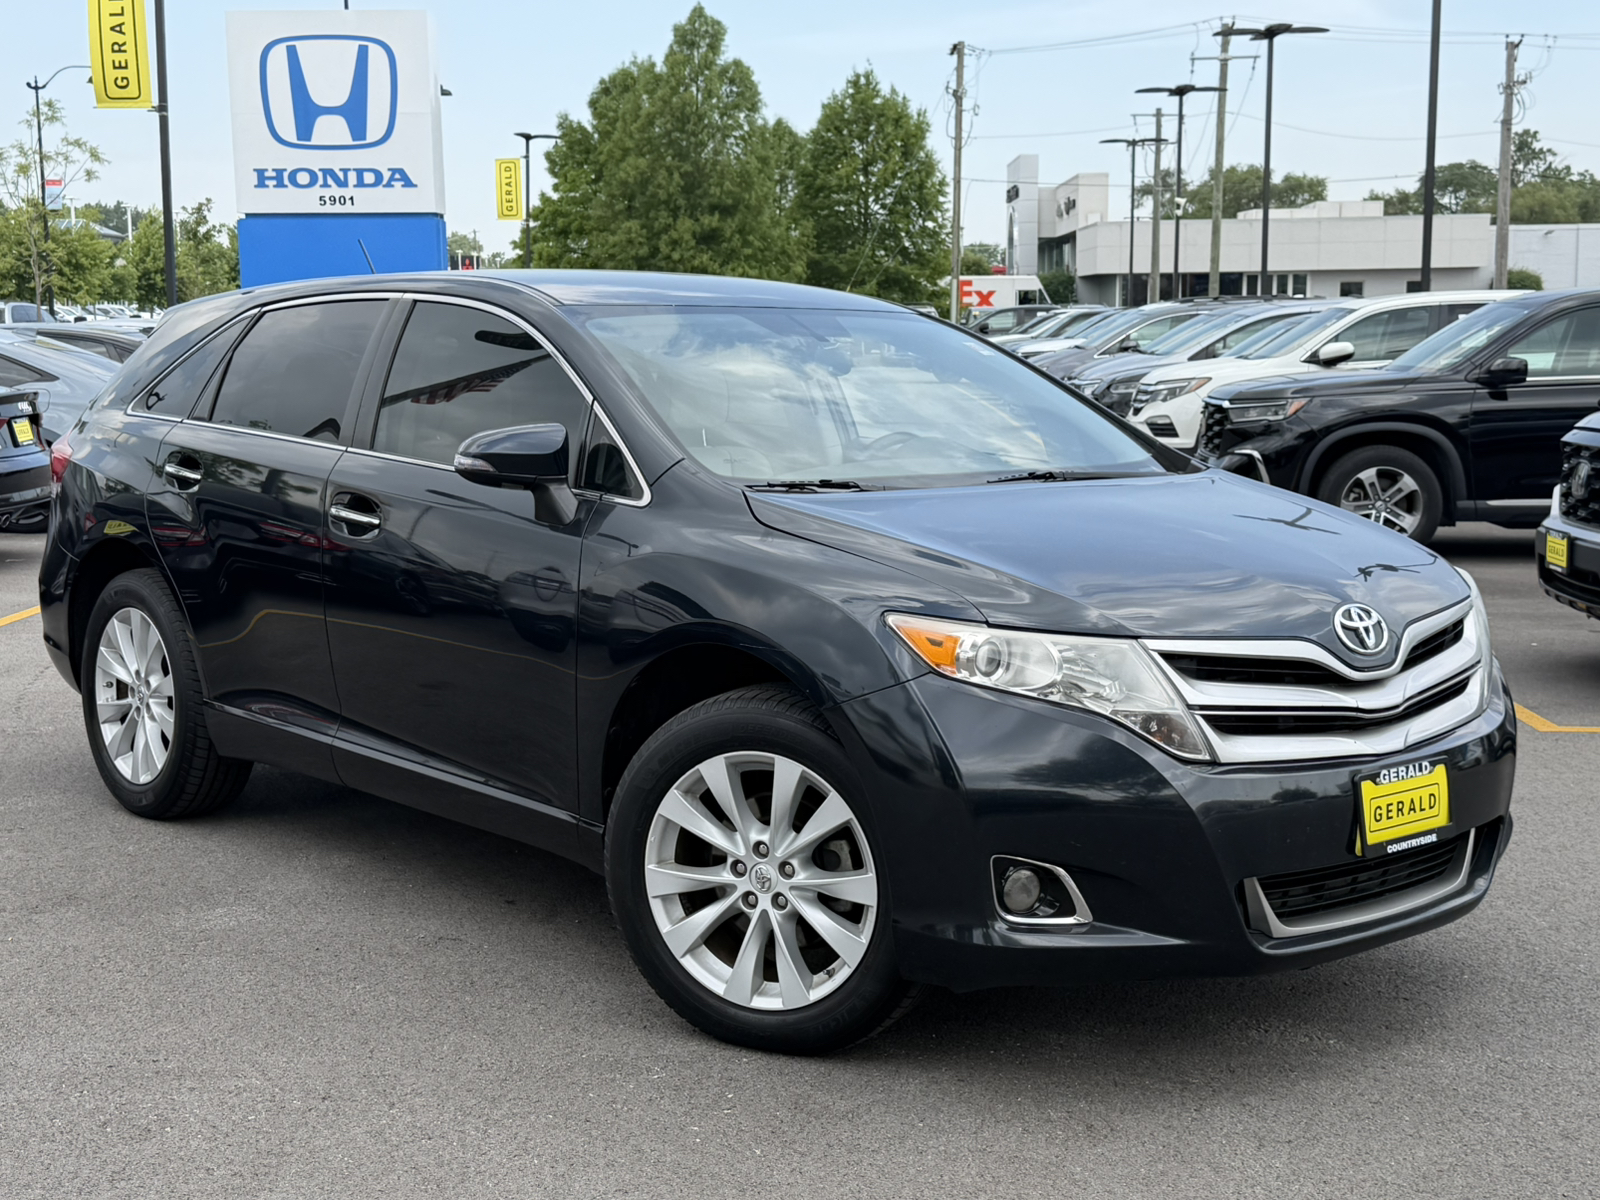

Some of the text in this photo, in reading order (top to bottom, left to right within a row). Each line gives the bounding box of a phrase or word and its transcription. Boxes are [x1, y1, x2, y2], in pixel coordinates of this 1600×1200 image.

[108, 0, 130, 90] GERAL
[253, 167, 418, 188] HONDA
[504, 166, 514, 212] GERALD
[318, 195, 355, 206] 5901
[1379, 761, 1430, 784] GERALD
[1373, 792, 1437, 823] GERALD
[1386, 833, 1438, 854] COUNTRYSIDE
